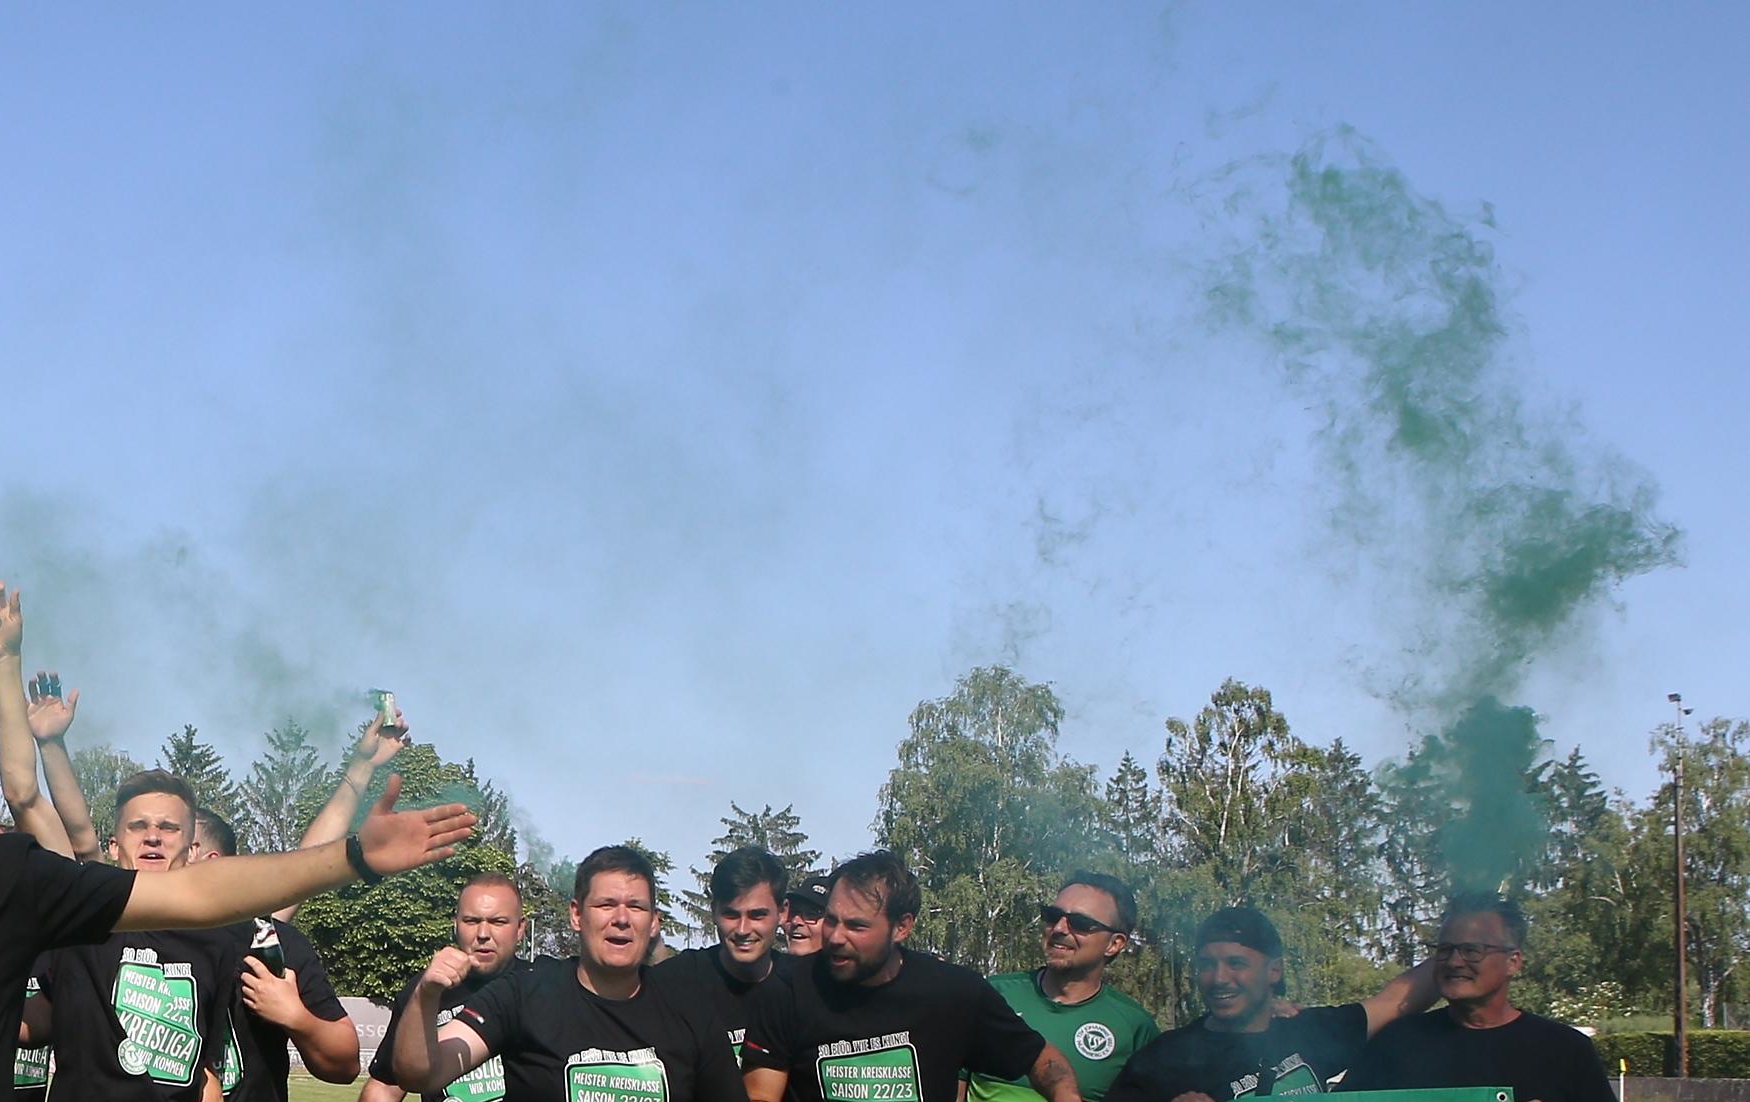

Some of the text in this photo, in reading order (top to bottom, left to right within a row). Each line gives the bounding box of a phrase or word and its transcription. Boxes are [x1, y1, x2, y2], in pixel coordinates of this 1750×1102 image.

[123, 970, 157, 991] MEISTER
[122, 989, 161, 1014] SAISON
[119, 1011, 195, 1061] KREISLIGA
[153, 1055, 187, 1078] KOMMEN
[826, 1066, 911, 1079] MEISTER KREISKLASSE
[469, 1082, 484, 1095] WIR
[574, 1072, 660, 1093] MEISTER KREISKLASSE
[831, 1082, 913, 1099] SAISON 22/23
